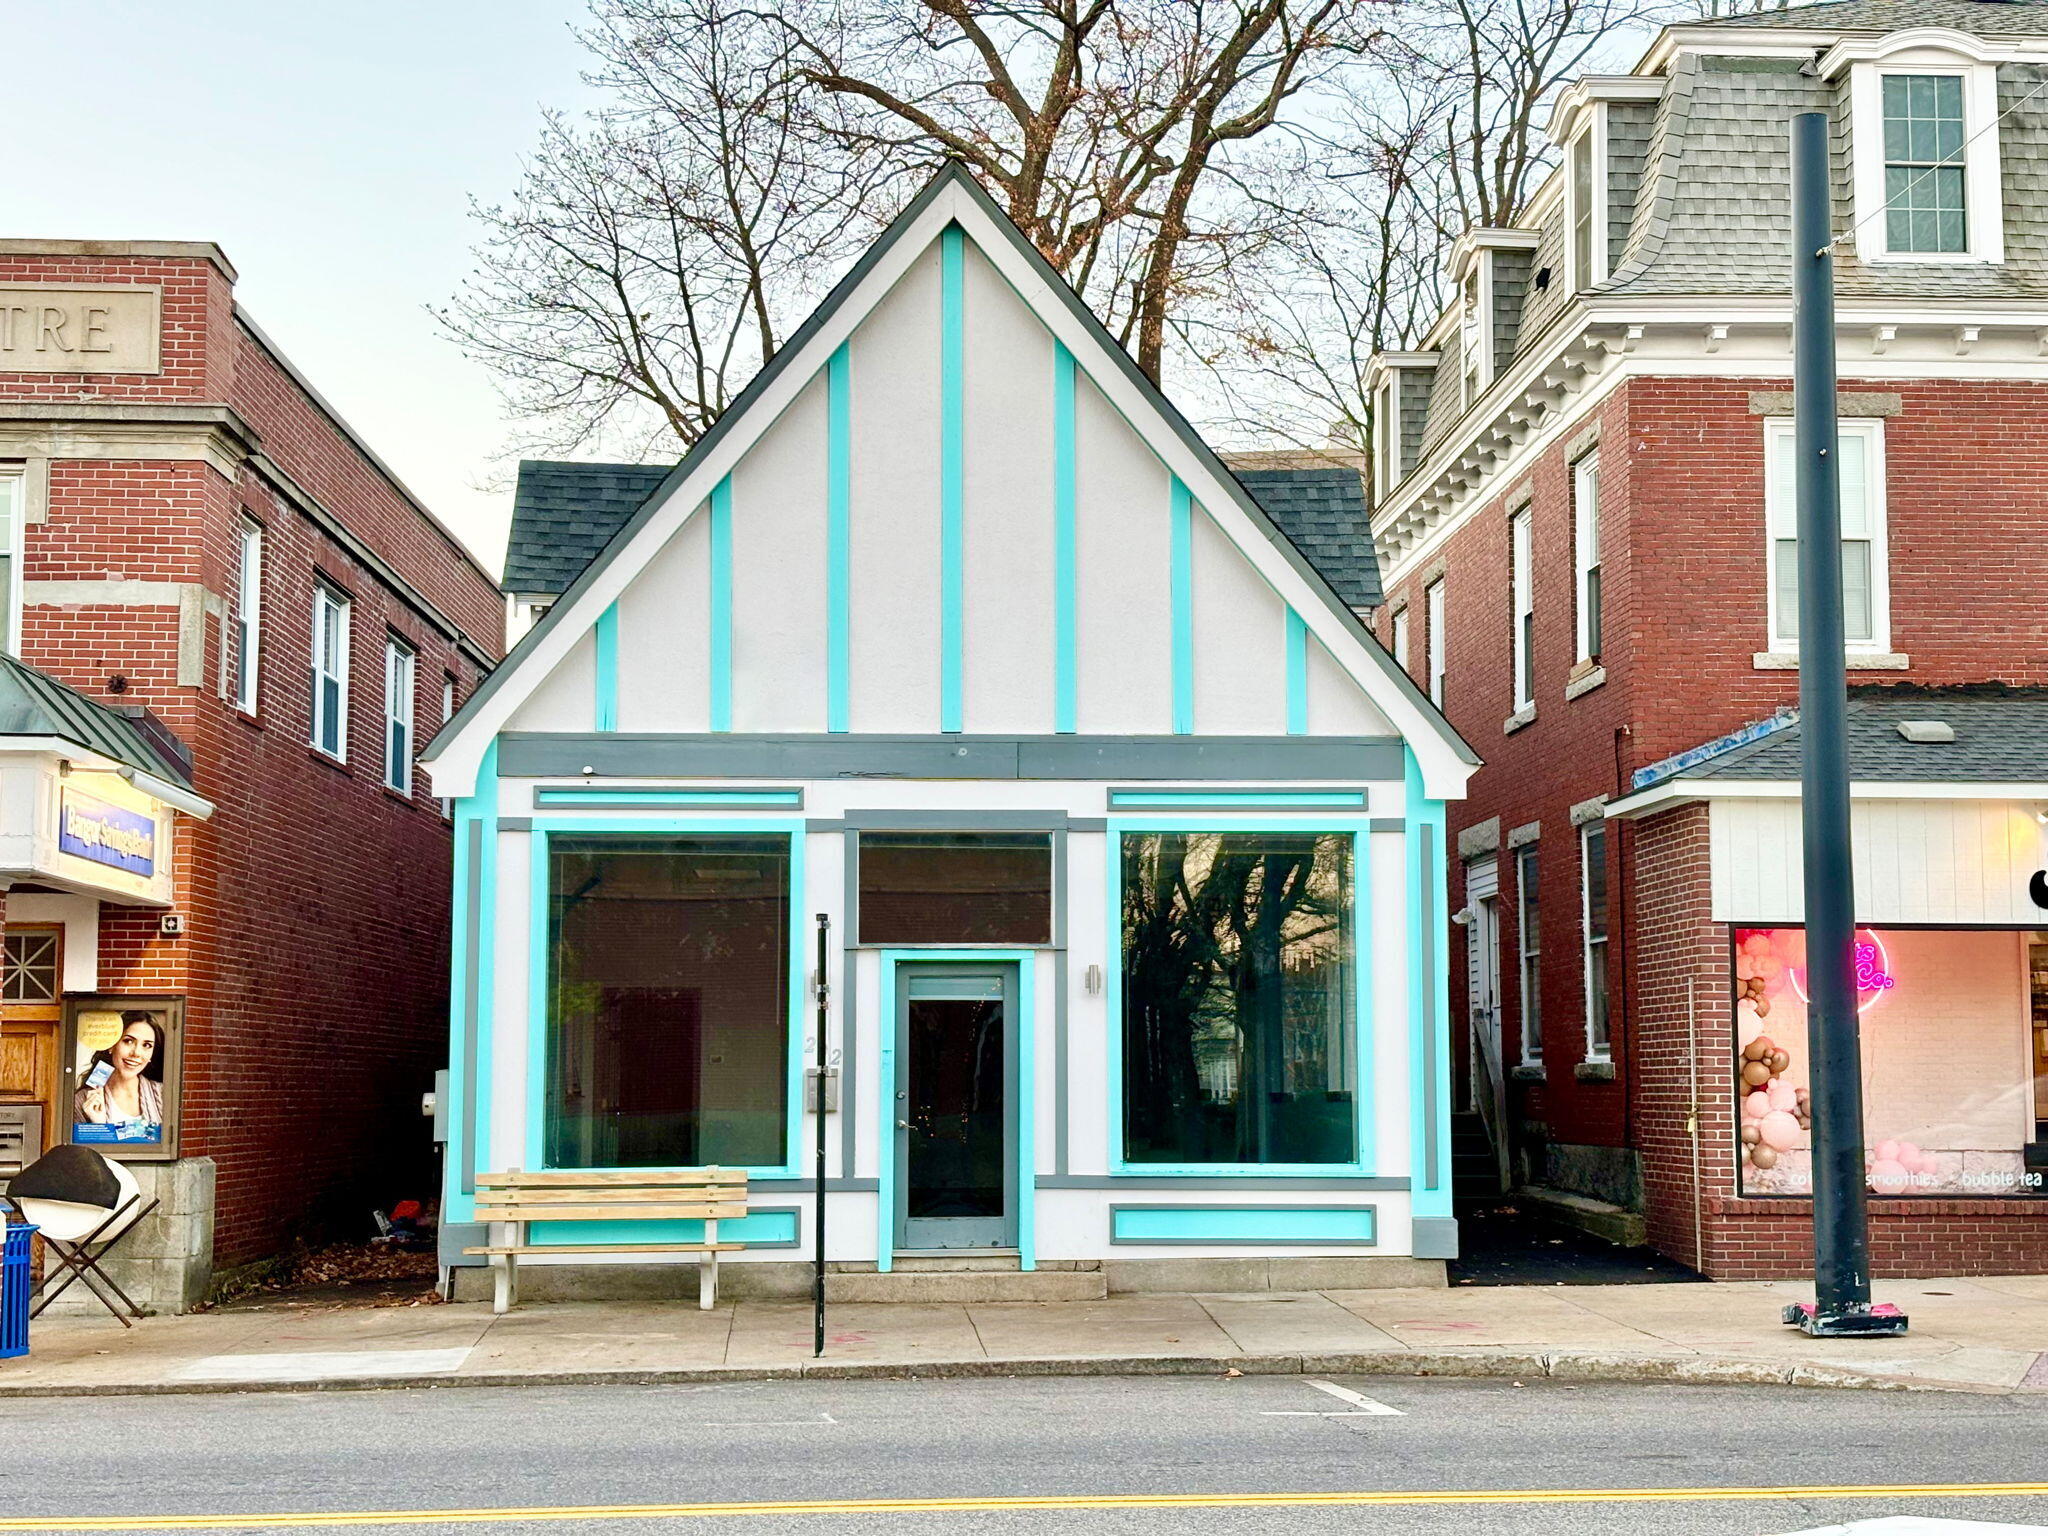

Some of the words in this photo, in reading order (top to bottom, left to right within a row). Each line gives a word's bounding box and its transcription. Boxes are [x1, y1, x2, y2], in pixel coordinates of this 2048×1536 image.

[1866, 1170, 1938, 1186] smoothies
[1962, 1171, 2014, 1187] bubble
[2018, 1172, 2043, 1187] tea
